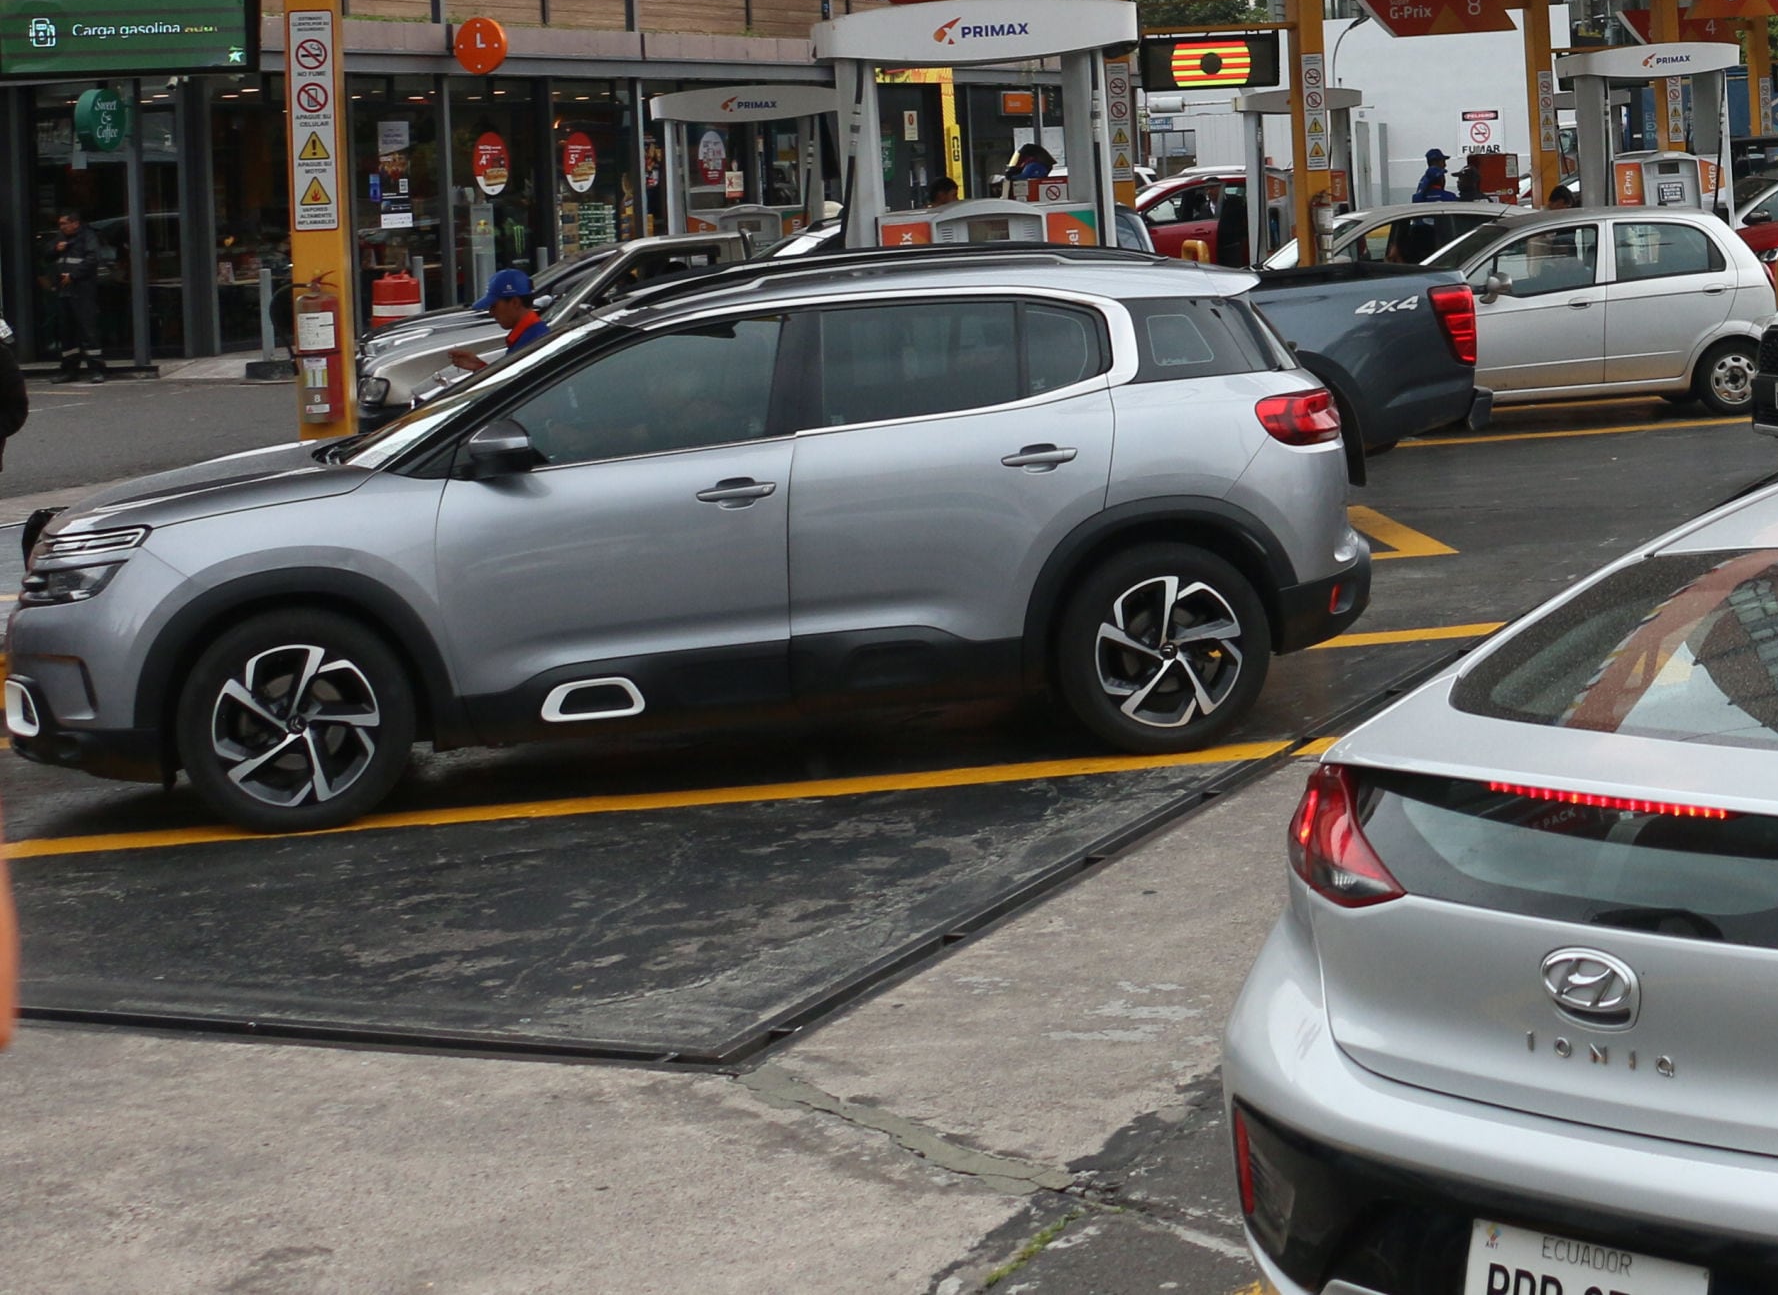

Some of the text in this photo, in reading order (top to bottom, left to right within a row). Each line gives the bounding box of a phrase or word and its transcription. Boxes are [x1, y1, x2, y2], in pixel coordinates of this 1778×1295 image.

[1389, 5, 1432, 20] G-Prix
[72, 23, 116, 39] Carga
[119, 21, 181, 38] gasolina
[961, 22, 1029, 39] PRIMAX
[1705, 19, 1717, 35] 4
[1656, 55, 1691, 65] PRIMAX
[737, 100, 777, 109] PRIMAX
[97, 124, 118, 143] Coffee
[1462, 144, 1500, 154] FUMAR
[1525, 1030, 1675, 1078] IONIQ
[1541, 1236, 1633, 1277] ECUADOR
